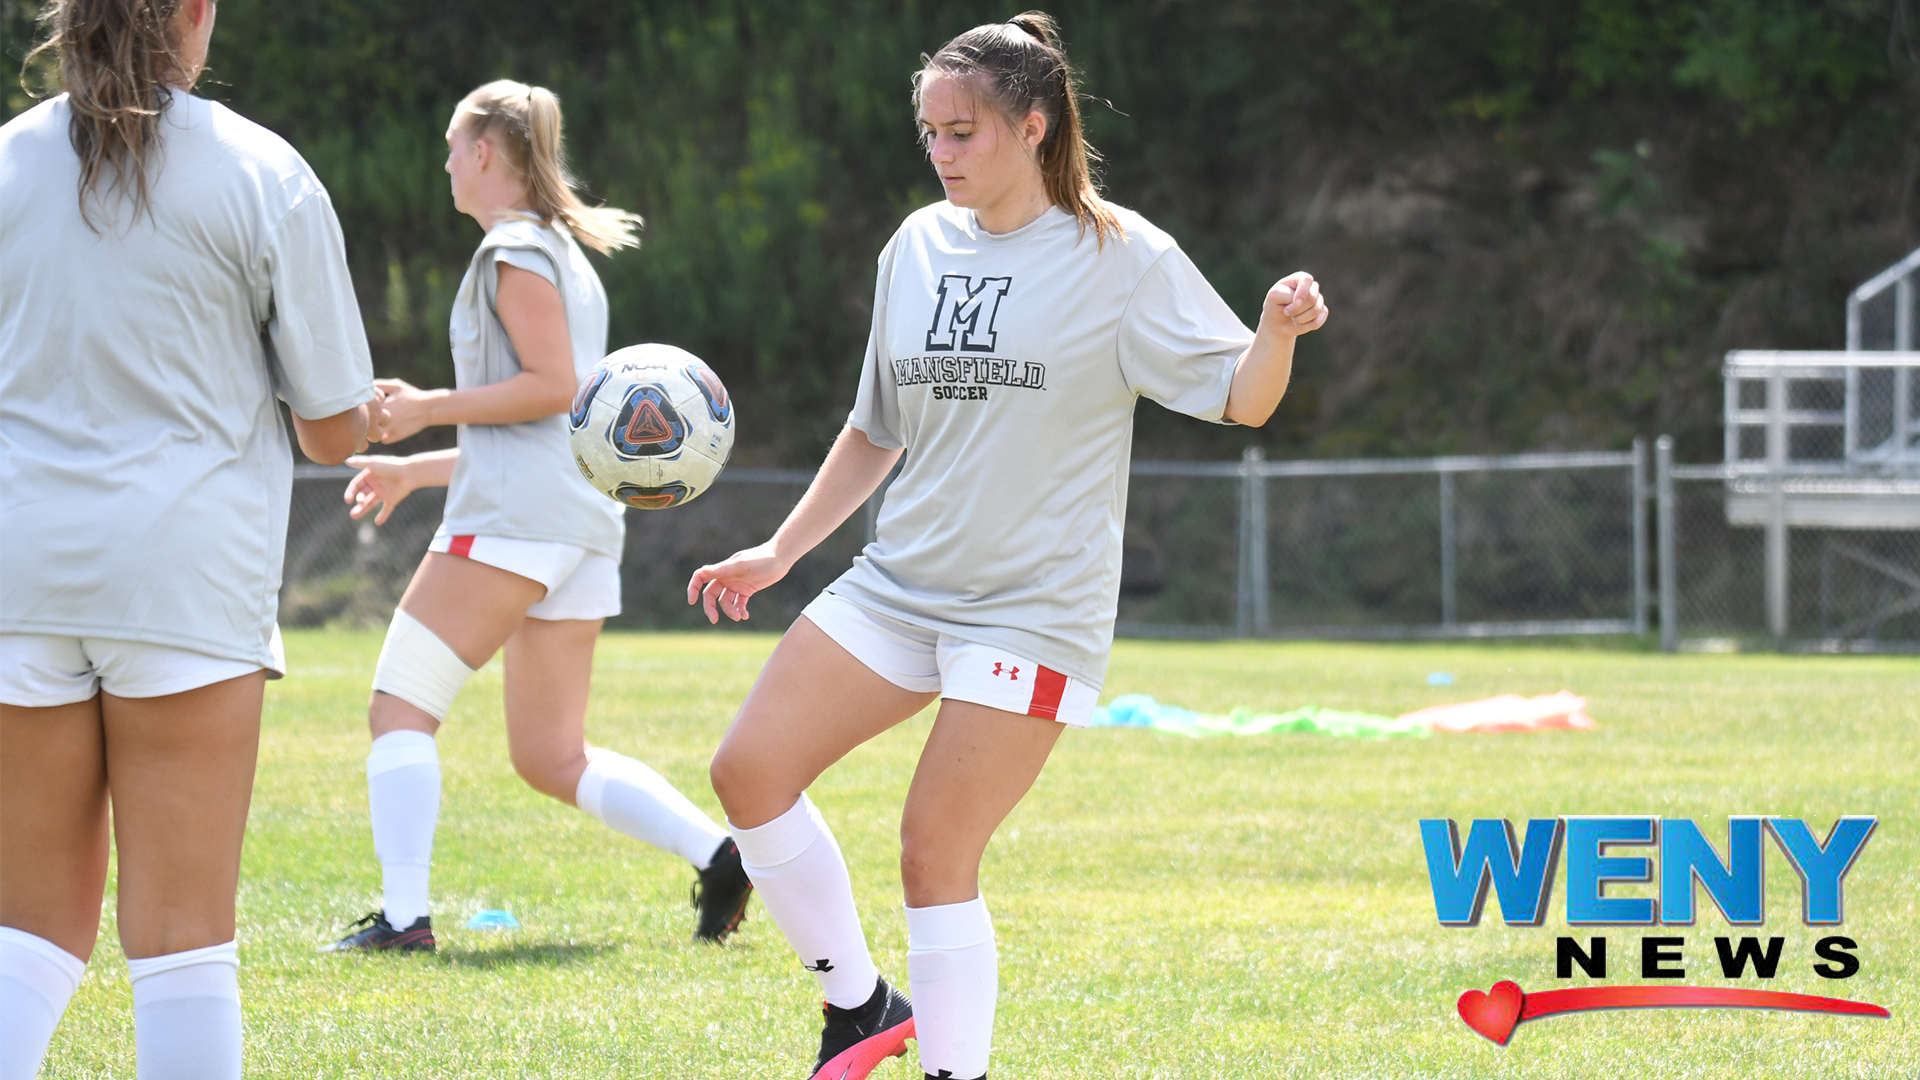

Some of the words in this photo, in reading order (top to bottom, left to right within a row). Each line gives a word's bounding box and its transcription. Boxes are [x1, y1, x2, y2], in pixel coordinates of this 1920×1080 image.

[925, 275, 1012, 352] M
[896, 356, 1045, 390] MANSFIELD
[933, 386, 988, 400] SOCCER
